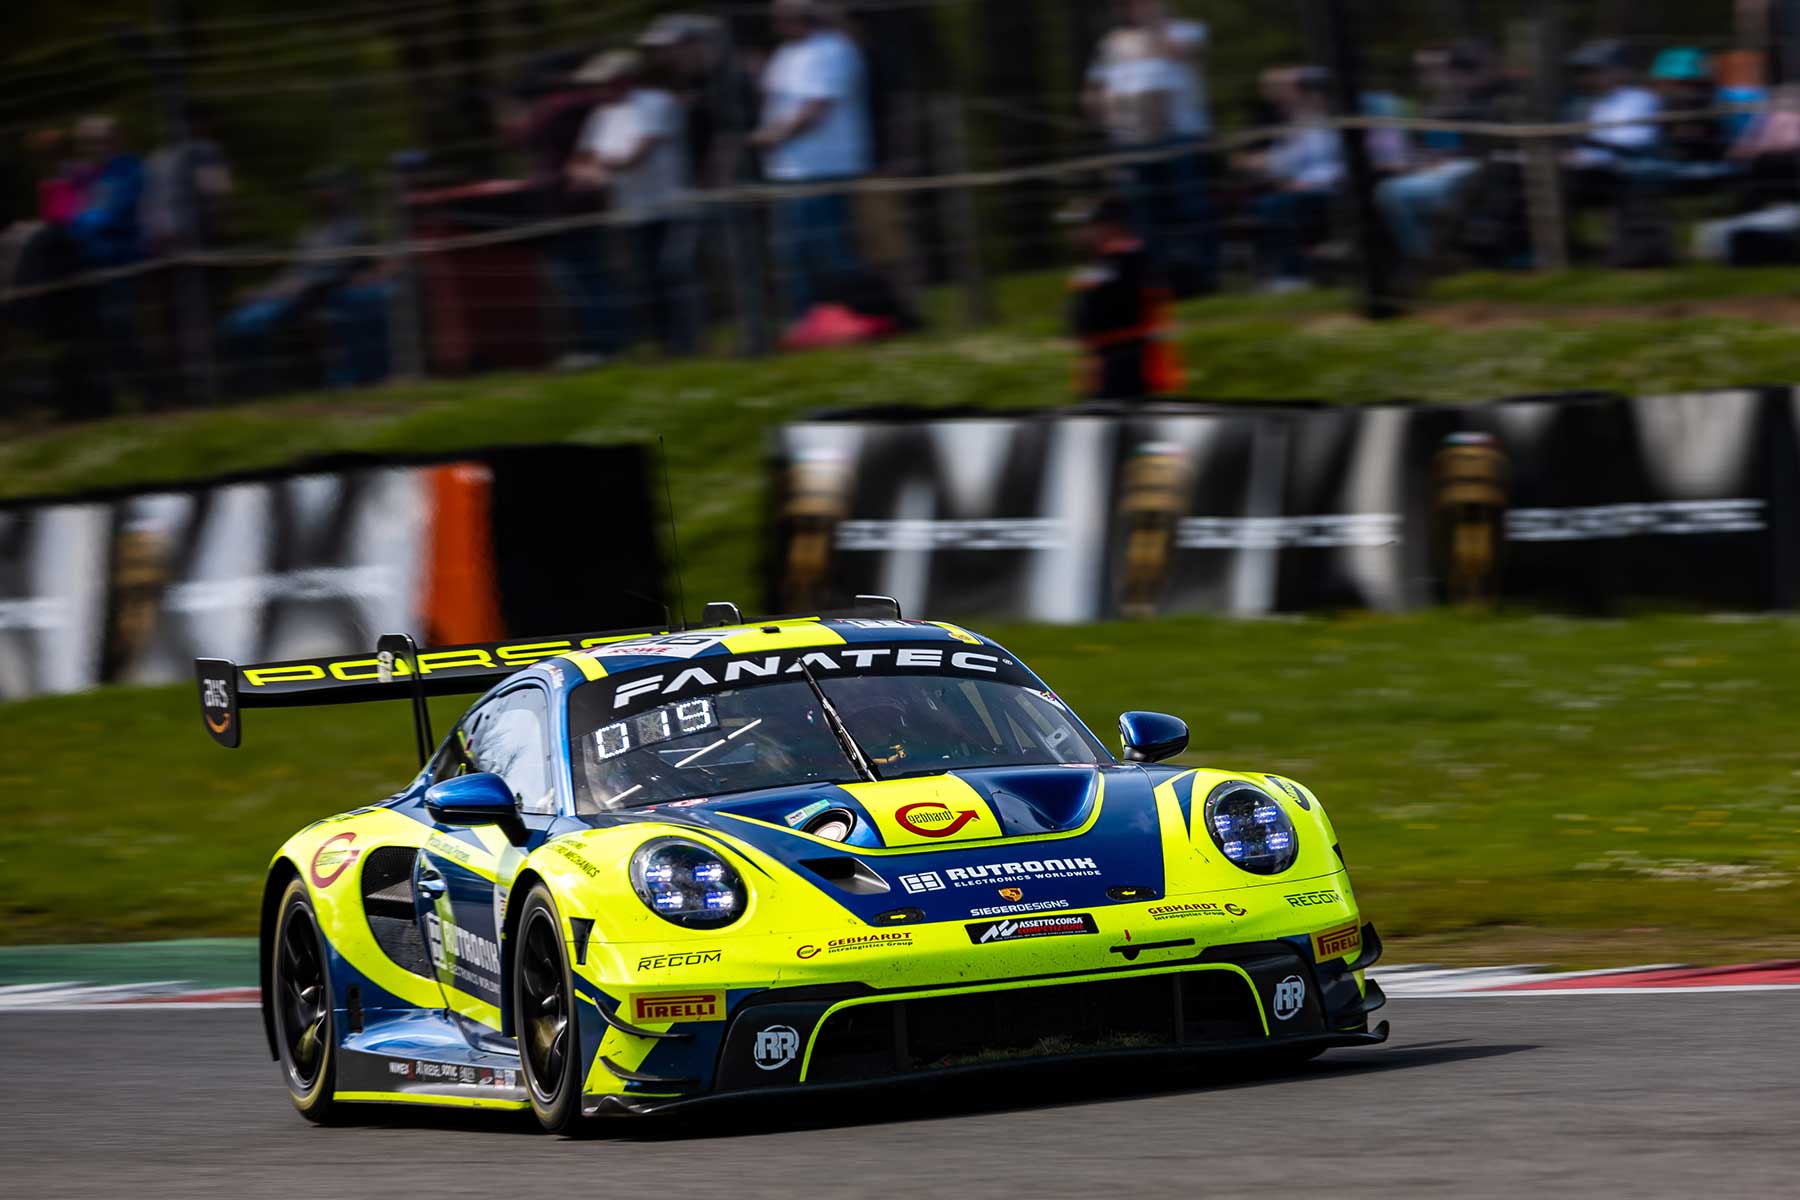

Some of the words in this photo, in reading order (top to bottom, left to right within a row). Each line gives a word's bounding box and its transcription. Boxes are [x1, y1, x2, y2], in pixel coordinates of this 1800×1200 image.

[242, 631, 669, 687] PORS
[613, 649, 998, 709] FANATEC
[907, 809, 955, 824] gebhardt
[945, 857, 1098, 880] RUTRONIK
[953, 874, 1031, 888] ELECTRONICS
[1034, 869, 1101, 879] WORLDWIDE
[970, 899, 1070, 917] SIEGERDESIGNS
[1283, 889, 1345, 908] RECOM
[1147, 903, 1218, 915] GEBHARDT
[1017, 924, 1085, 935] COMPETIZIONE
[1019, 918, 1055, 929] ASSETTO
[1055, 916, 1084, 925] CORSA
[827, 932, 912, 947] GEBHARDT
[1317, 925, 1360, 957] PIRELLI
[637, 949, 723, 972] RECOM
[636, 994, 716, 1019] PIRELLI
